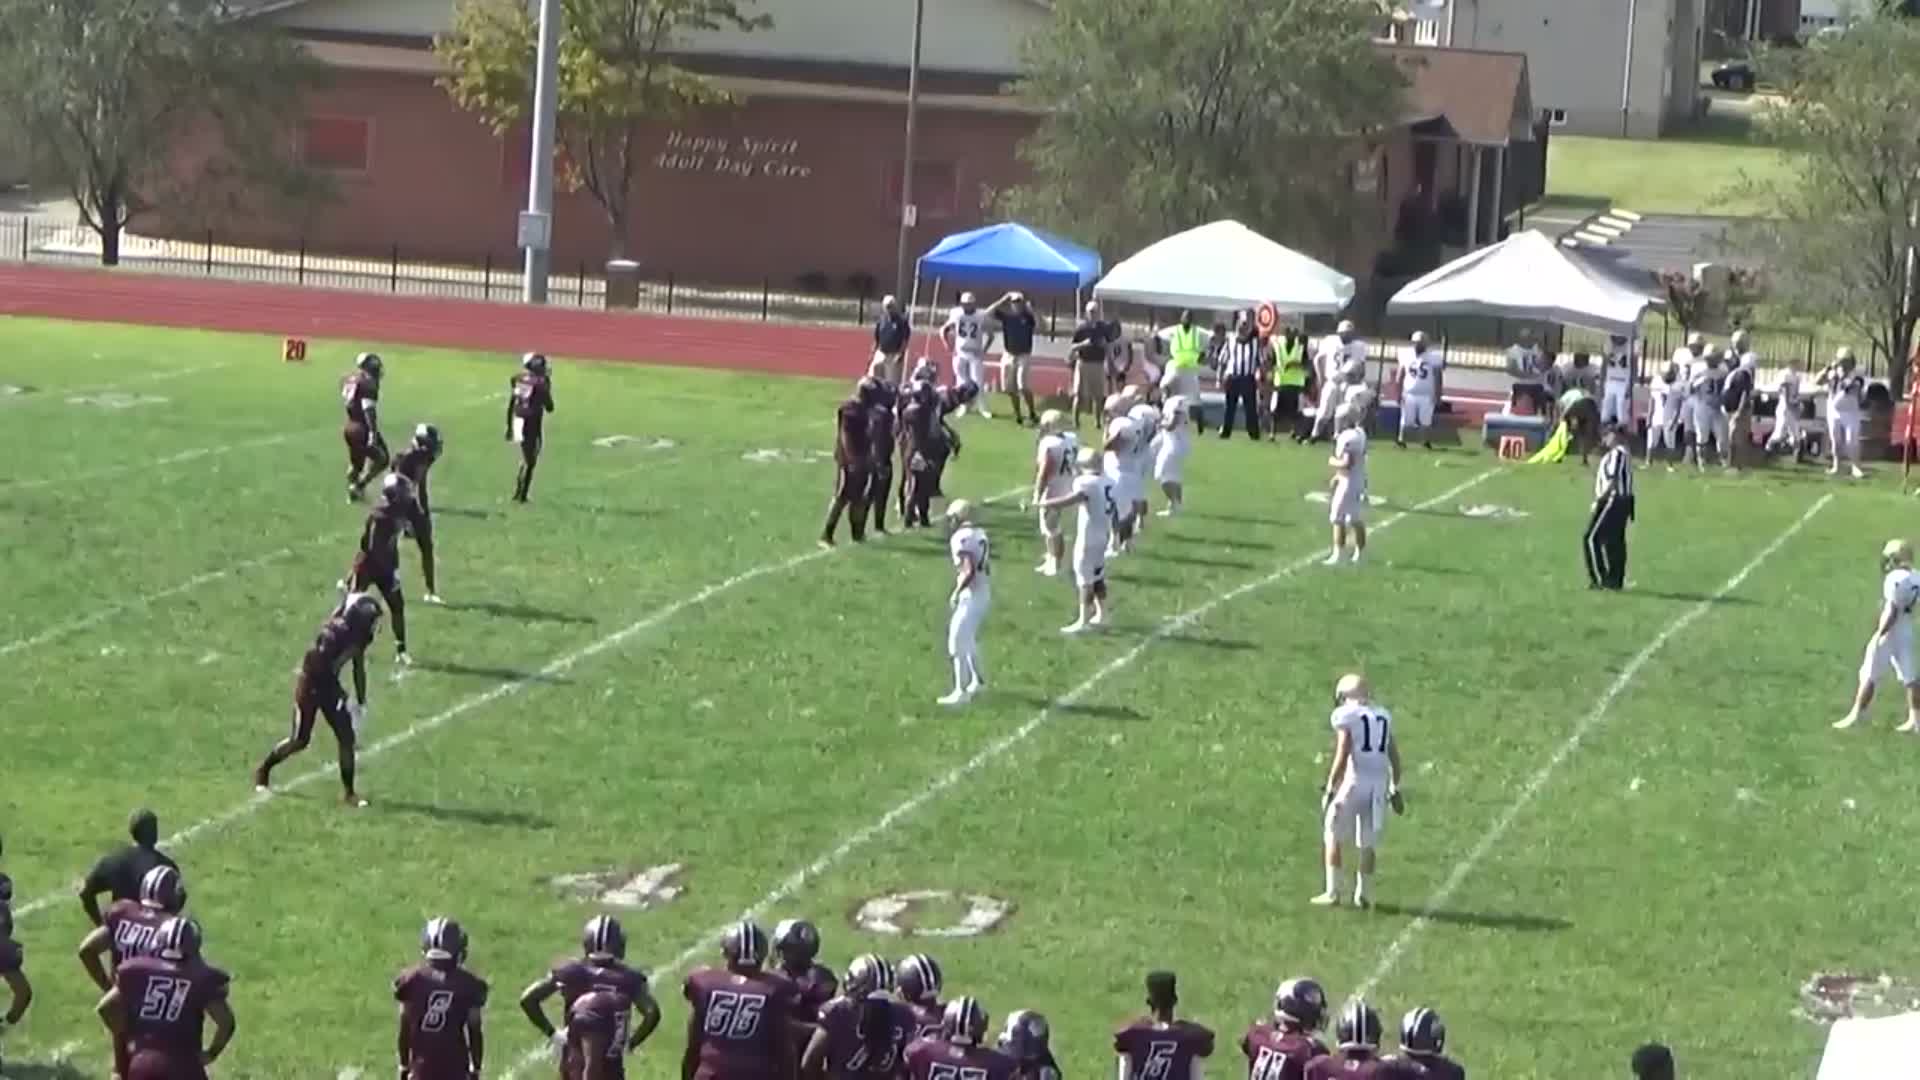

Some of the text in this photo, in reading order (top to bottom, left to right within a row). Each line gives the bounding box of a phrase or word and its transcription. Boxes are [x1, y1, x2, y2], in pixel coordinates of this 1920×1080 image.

[666, 129, 799, 155] Happy Spirit
[714, 155, 753, 177] Day
[763, 160, 812, 177] Care
[285, 339, 306, 361] 20
[1502, 439, 1523, 459] 40
[1361, 714, 1388, 752] 17
[139, 975, 192, 1022] 51
[420, 990, 454, 1032] 8
[703, 989, 766, 1039] 66
